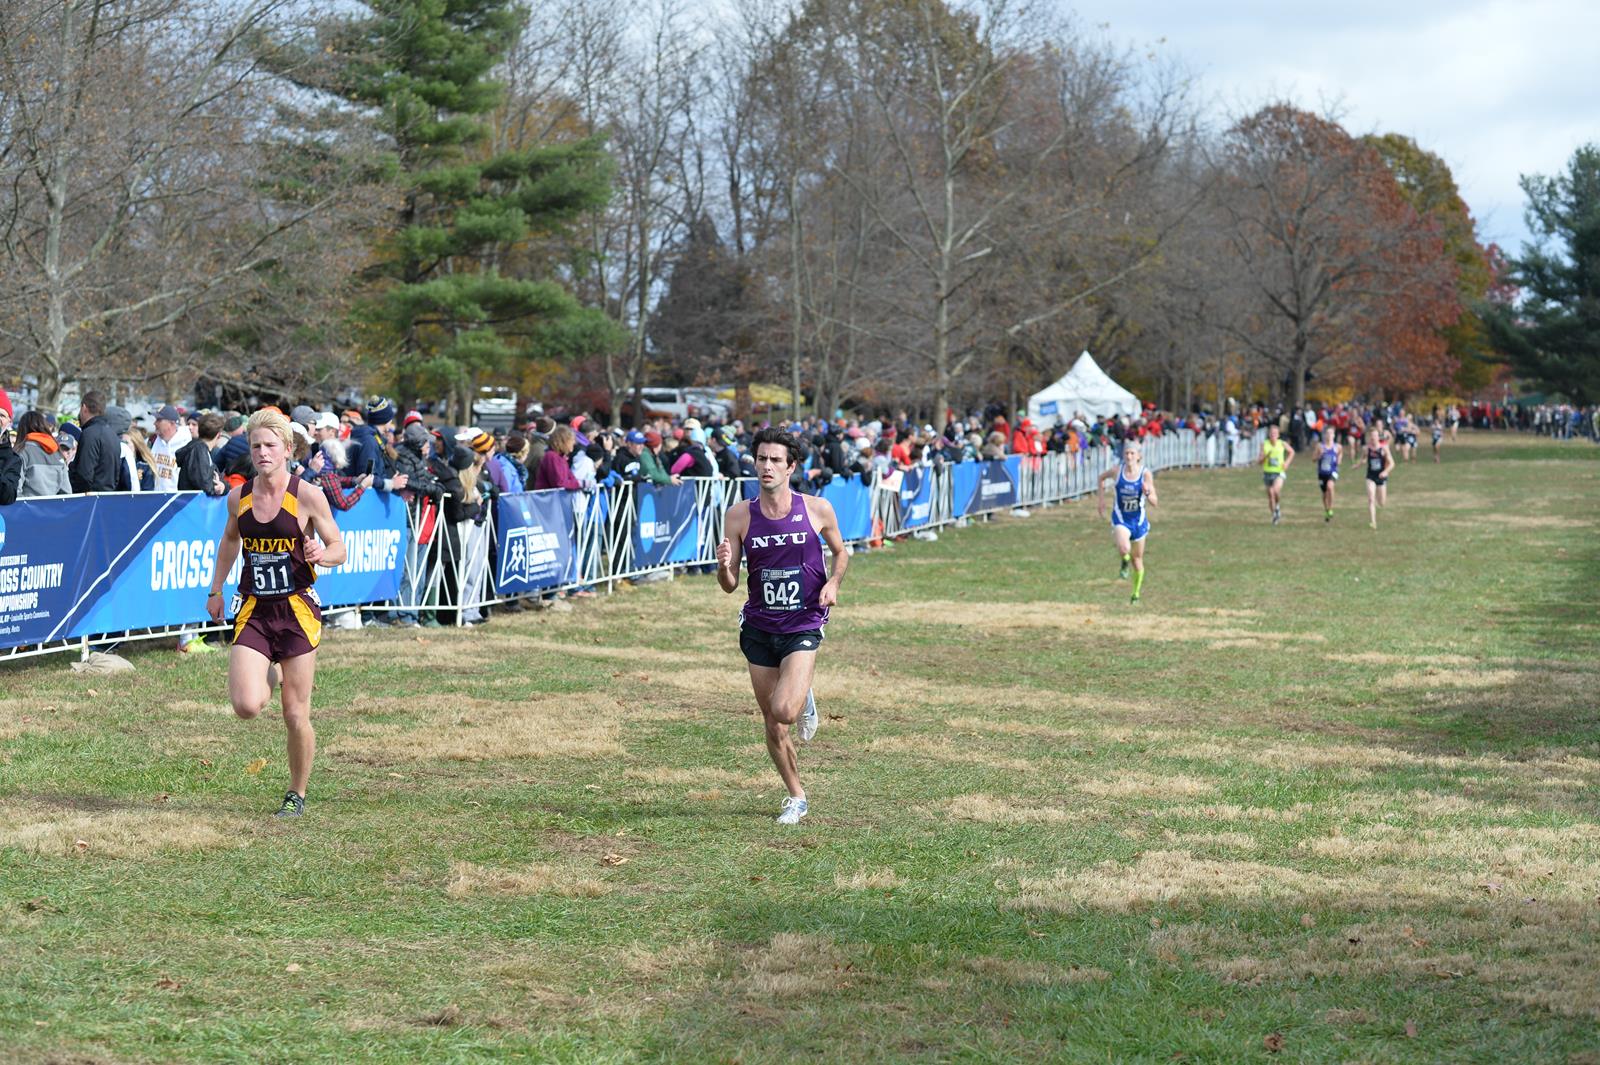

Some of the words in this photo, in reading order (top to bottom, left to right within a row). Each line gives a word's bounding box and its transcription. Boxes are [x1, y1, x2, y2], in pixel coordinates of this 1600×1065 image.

[243, 537, 297, 553] CALVIN
[751, 532, 808, 549] NYU
[151, 540, 214, 591] CROSS
[253, 565, 289, 590] 511
[0, 567, 20, 594] OSS
[20, 563, 64, 591] COUNTRY
[763, 581, 801, 605] 642
